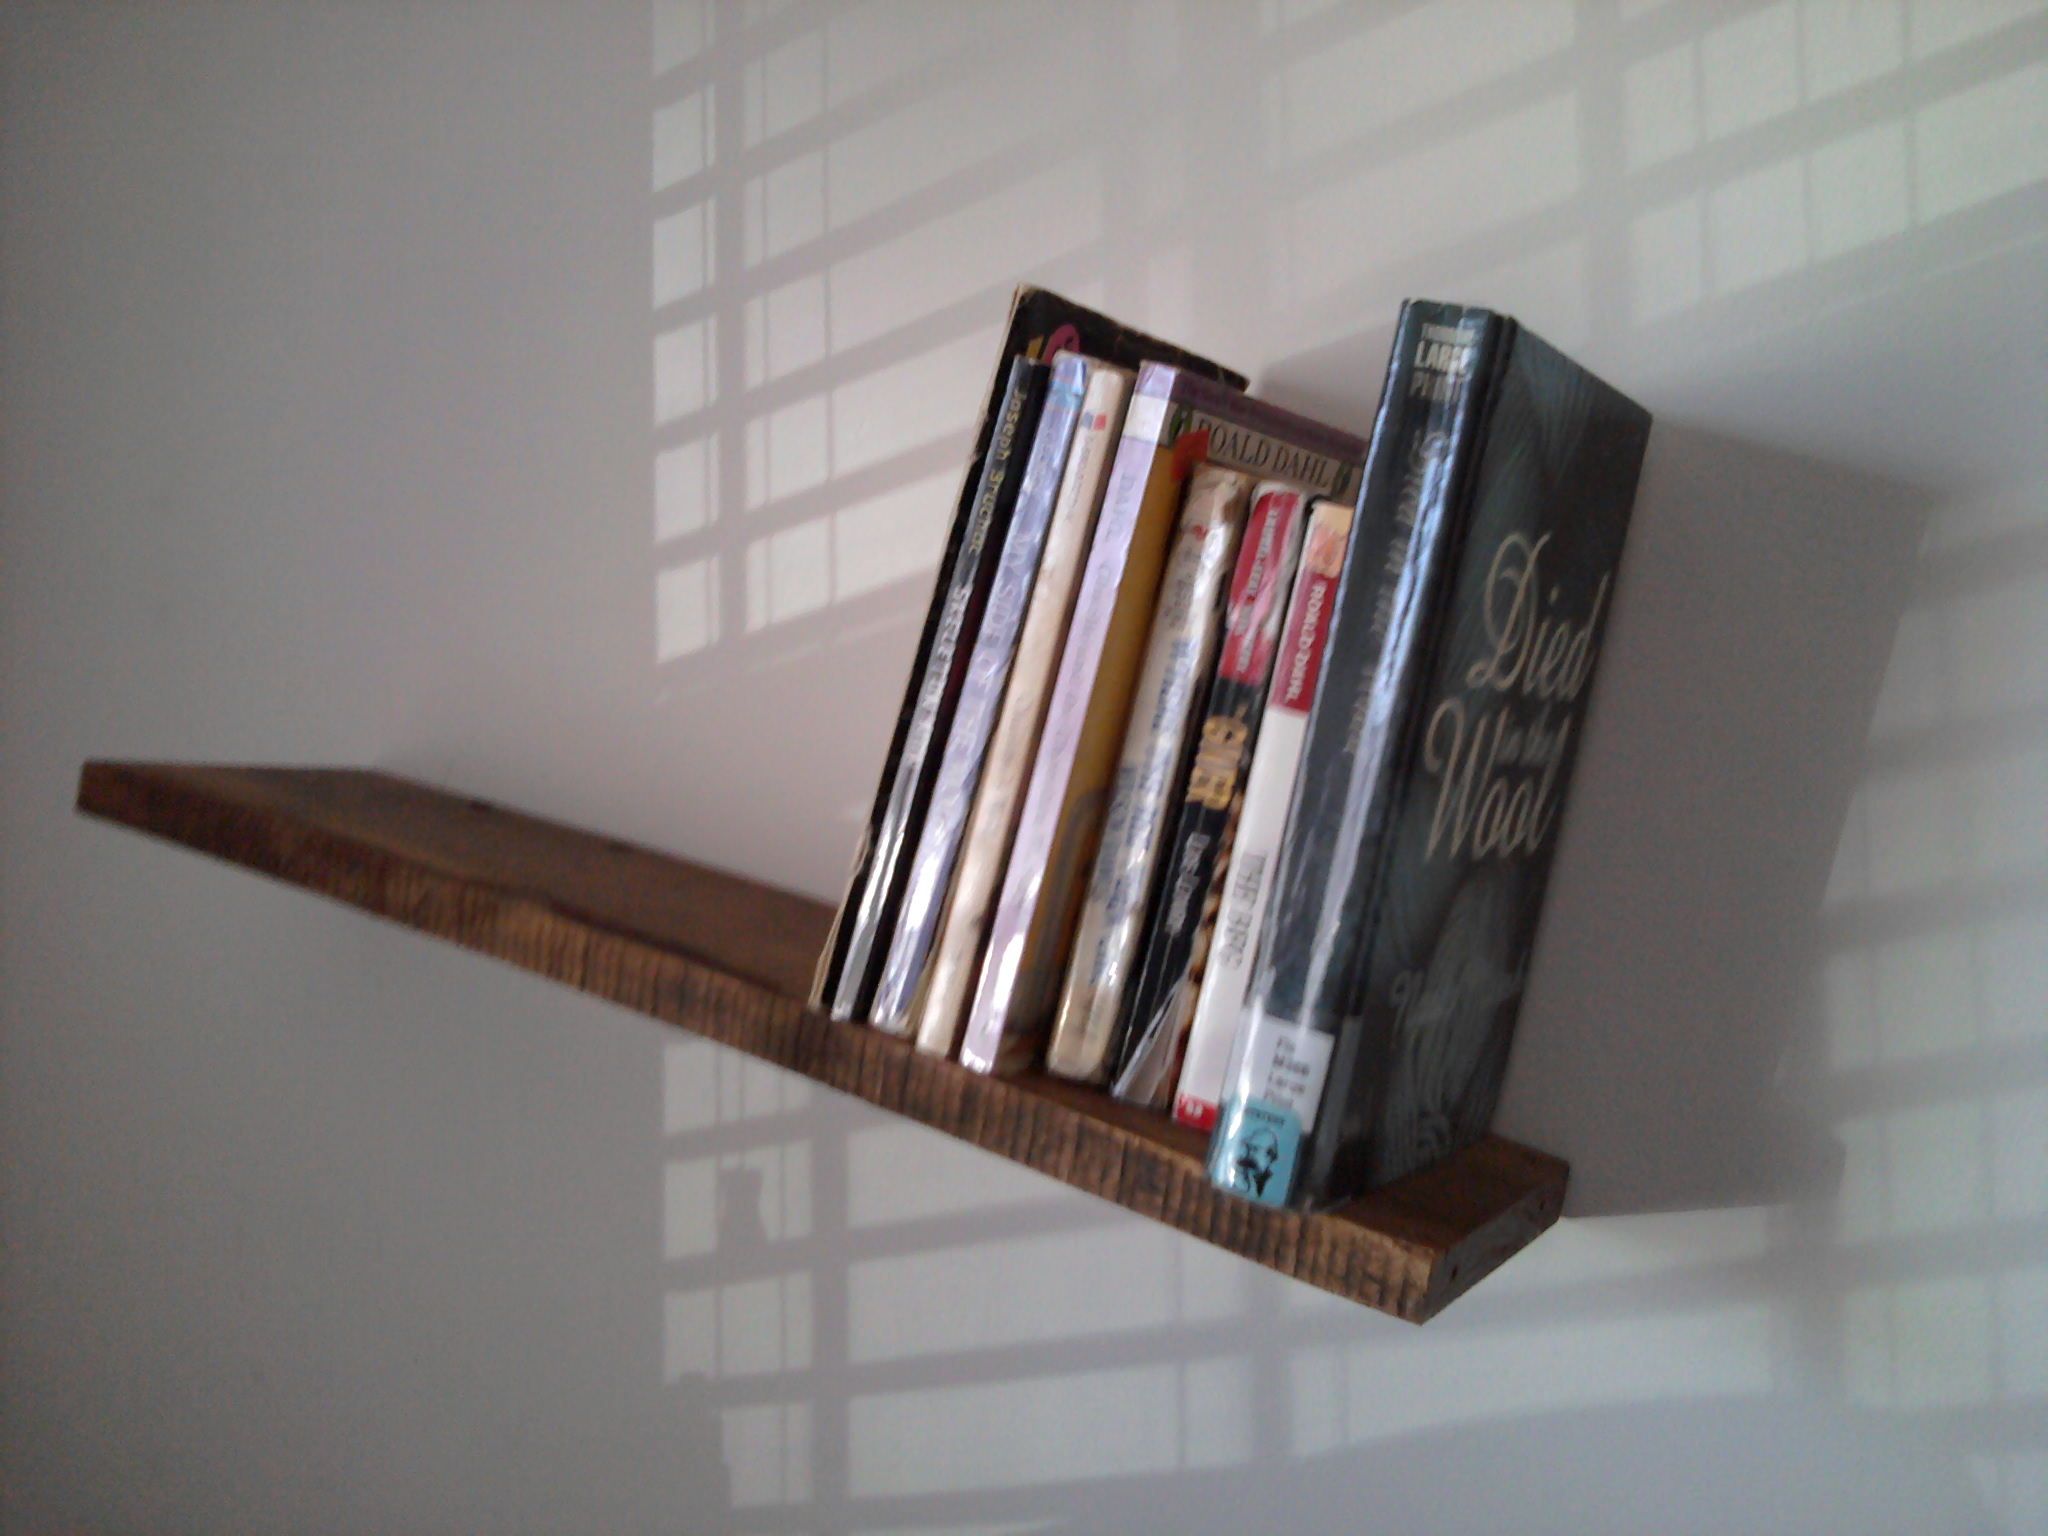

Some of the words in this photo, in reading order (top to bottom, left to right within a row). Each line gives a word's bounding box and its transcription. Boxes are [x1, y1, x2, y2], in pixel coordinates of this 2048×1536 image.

[1408, 370, 1466, 403] PRINT
[1413, 340, 1473, 375] LARGE
[999, 387, 1027, 461] Joseph
[1271, 447, 1329, 488] DAHL
[1298, 583, 1325, 651] ROALD
[1466, 532, 1609, 699] Died
[1425, 697, 1572, 864] Wool
[1232, 849, 1266, 908] THE
